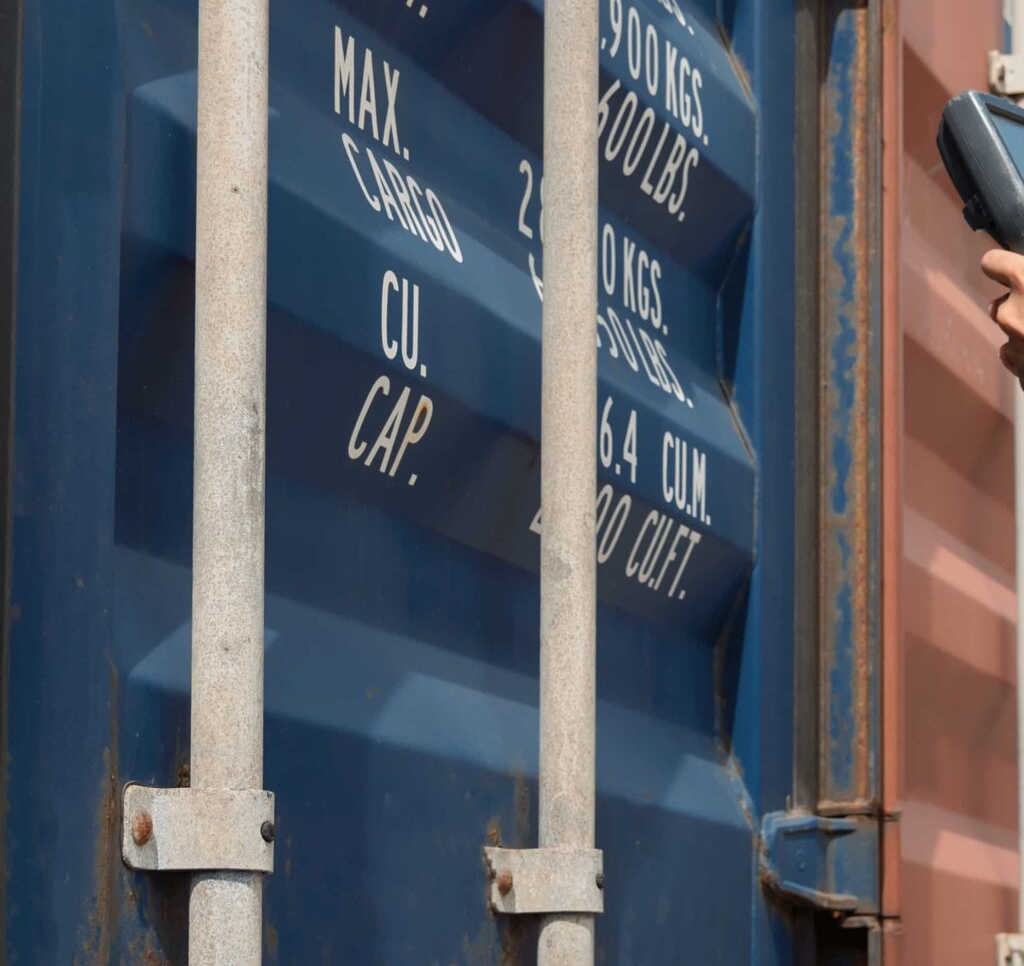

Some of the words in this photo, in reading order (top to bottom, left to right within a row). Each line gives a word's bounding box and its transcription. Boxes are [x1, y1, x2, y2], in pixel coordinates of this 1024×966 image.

[334, 25, 409, 161] MAX.
[341, 133, 463, 264] CARGO
[381, 269, 427, 378] CU.
[623, 236, 669, 336] KGS.
[347, 375, 433, 486] CAP.
[599, 396, 638, 484] 6.4
[662, 431, 711, 526] CU.M.
